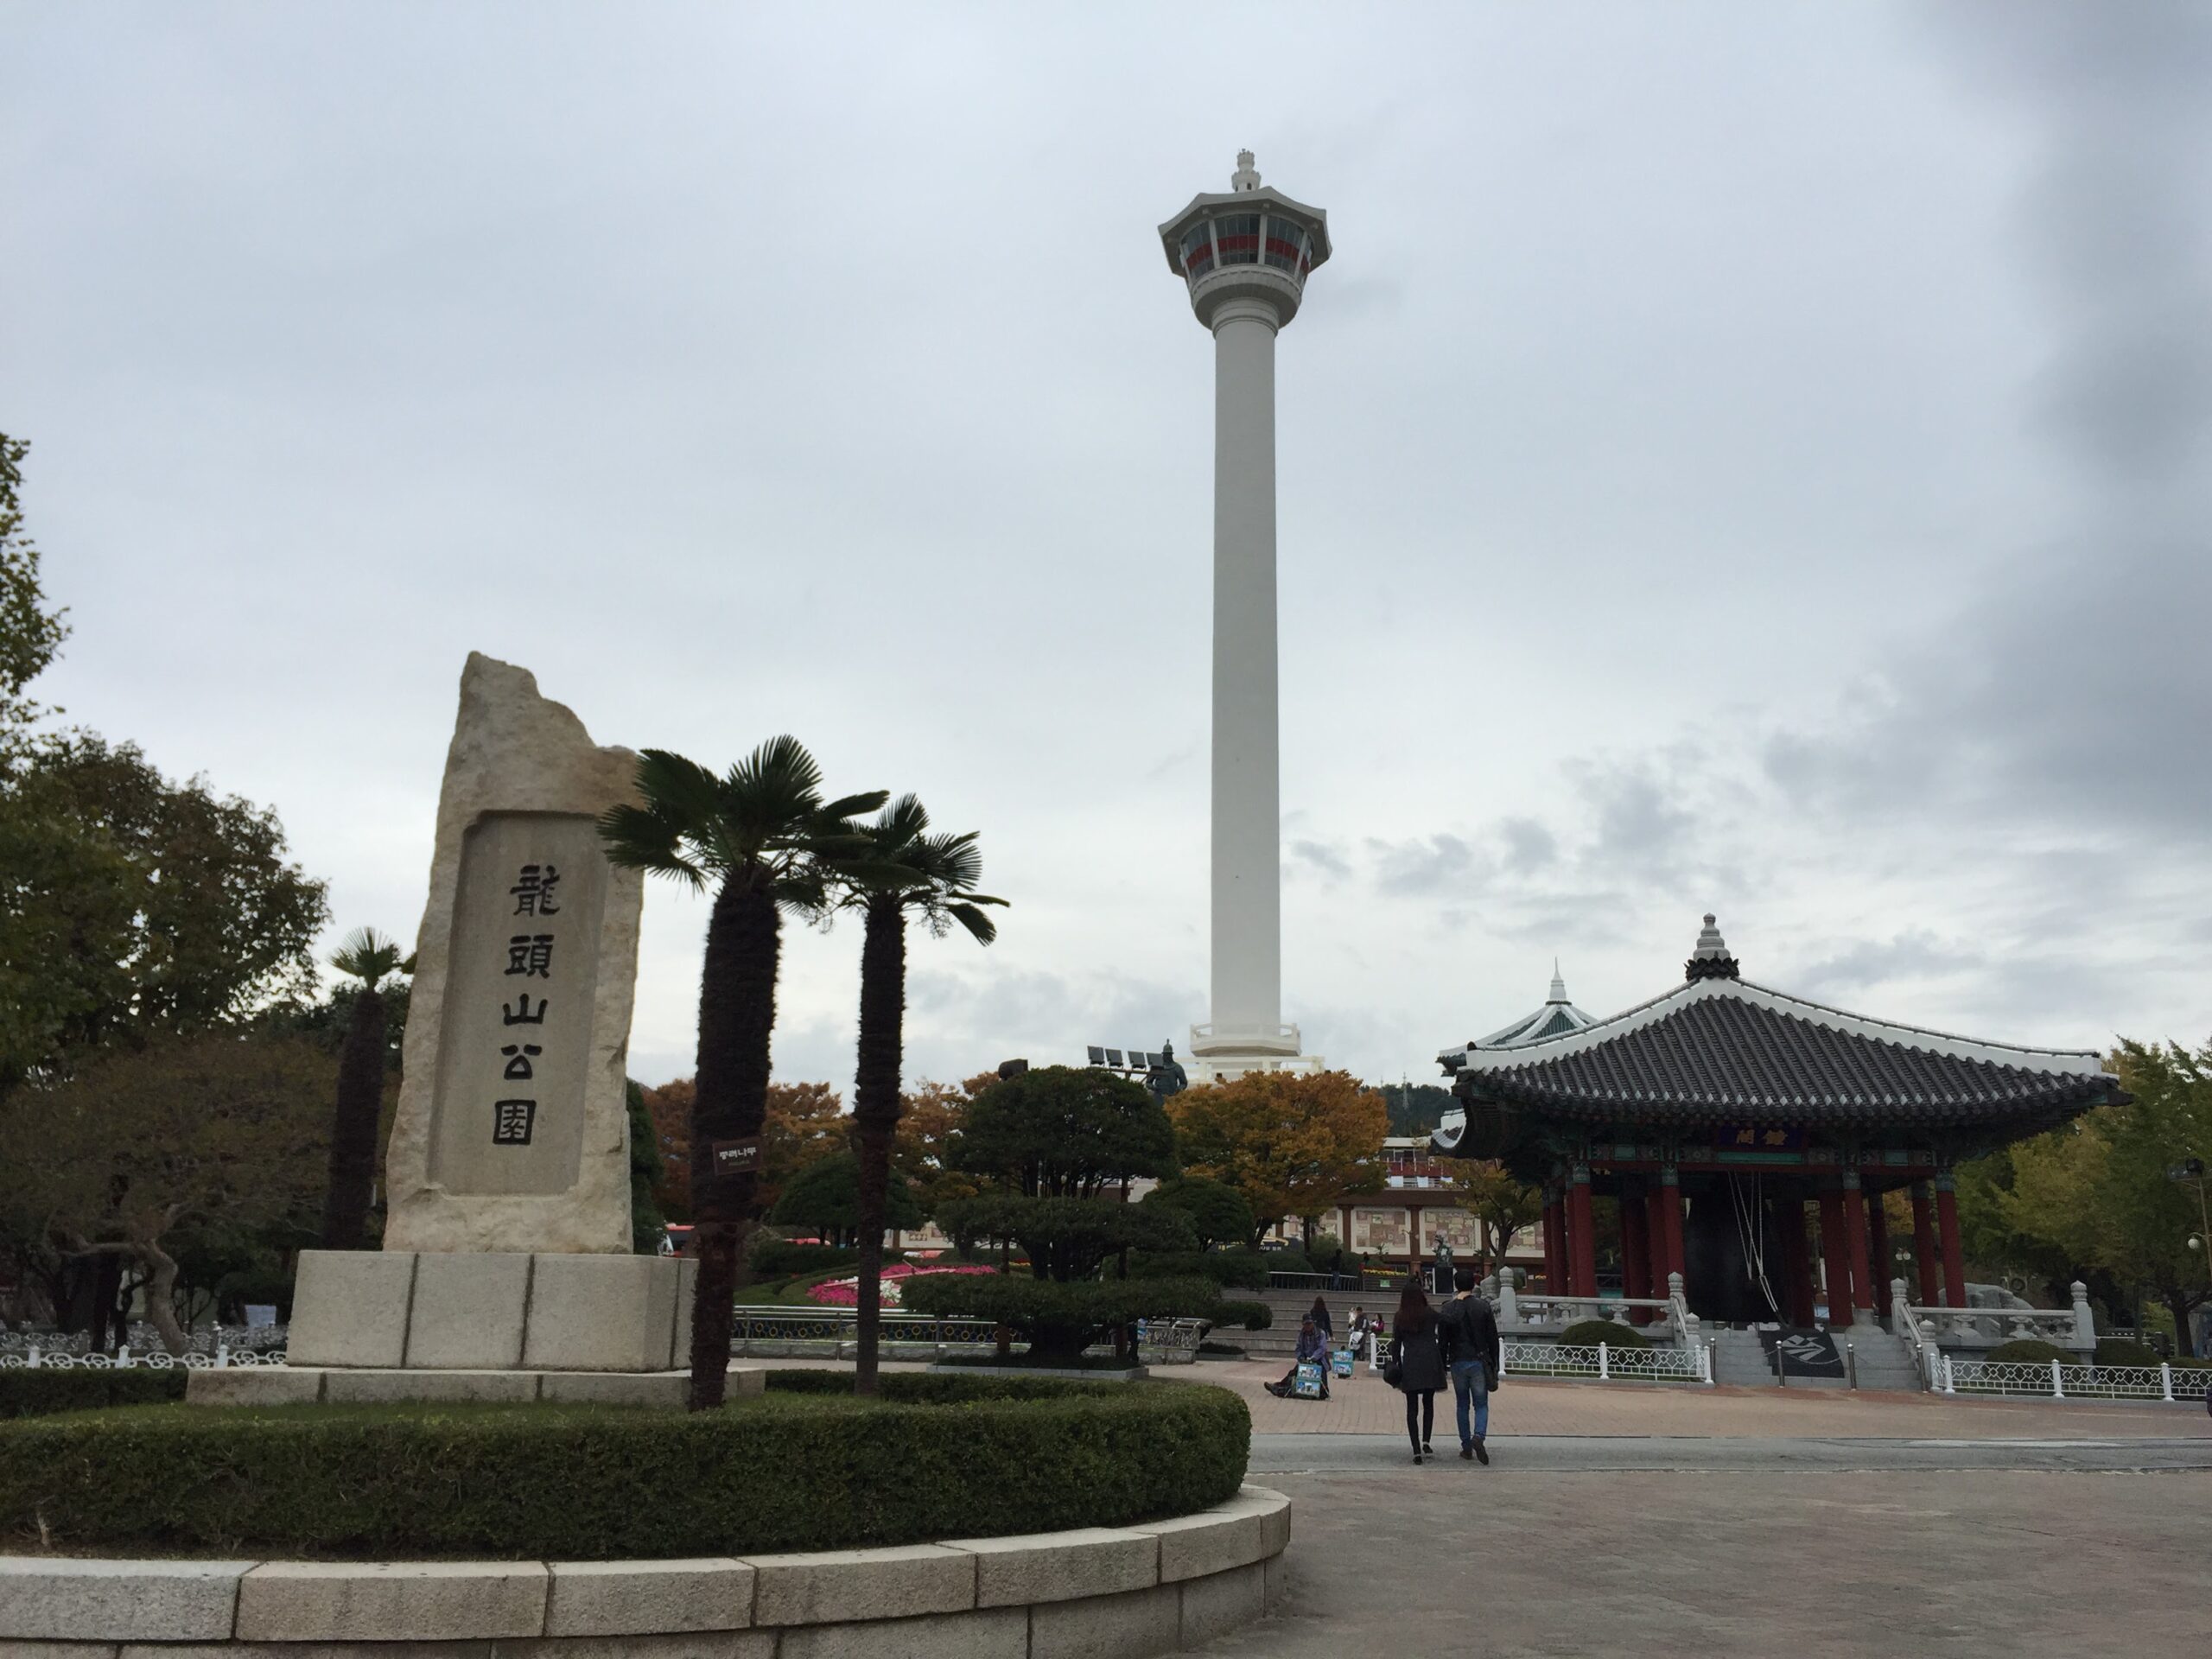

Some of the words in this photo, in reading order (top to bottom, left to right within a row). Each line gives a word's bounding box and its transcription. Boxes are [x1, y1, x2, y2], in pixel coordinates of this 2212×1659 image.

[493, 864, 561, 1146] 龍頭山公園
